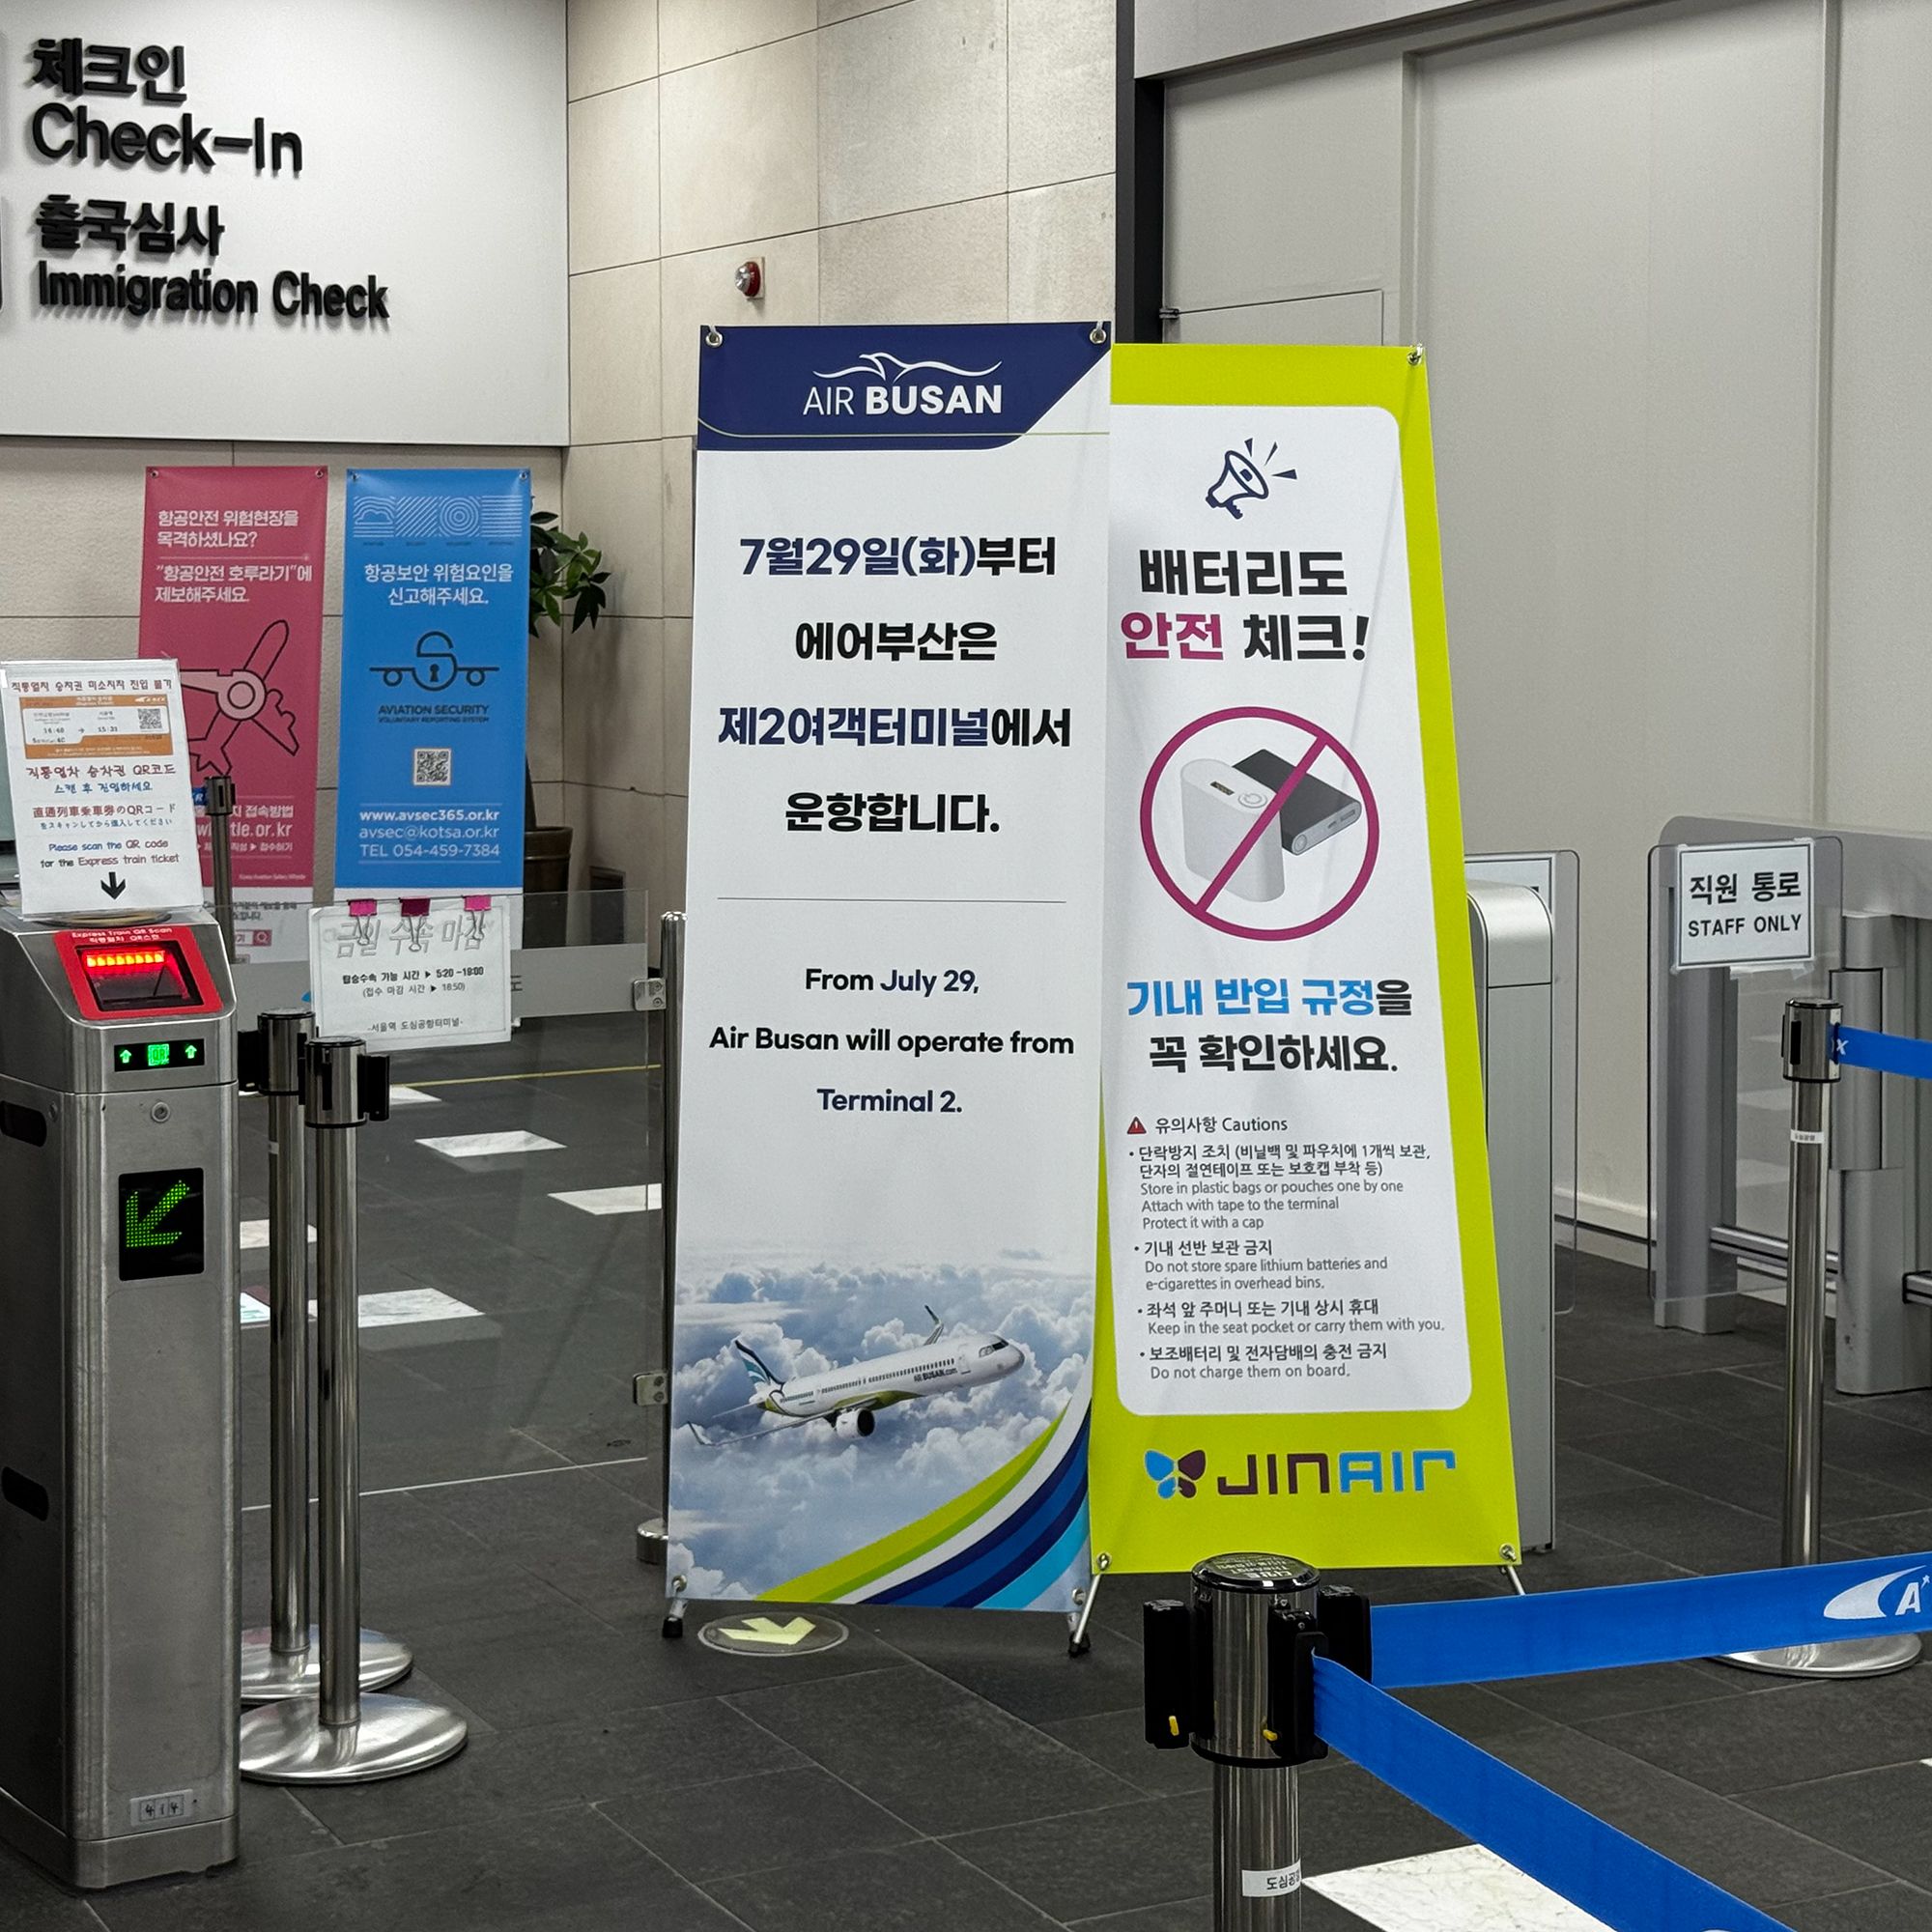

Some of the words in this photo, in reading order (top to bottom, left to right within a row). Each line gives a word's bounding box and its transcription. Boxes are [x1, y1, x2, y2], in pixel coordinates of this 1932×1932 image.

[32, 38, 186, 102] 체크인
[32, 102, 302, 172] Check-In
[36, 194, 224, 256] 출국심사
[39, 261, 258, 316] Immigration
[272, 270, 389, 319] Check
[803, 386, 854, 415] AIR
[866, 384, 1002, 414] BUSAN
[158, 510, 218, 526] 항공안전
[223, 510, 298, 526] 위험현장을
[157, 531, 258, 548] 목격하셨나요?
[740, 536, 1056, 576] 7월29일(화)부터
[365, 563, 429, 582] 항공보안
[434, 563, 514, 582] 위험요인을
[1139, 549, 1348, 597] 배터리도
[155, 586, 249, 603] 제보해주세요.
[388, 587, 489, 606] 신고해주세요.
[795, 622, 997, 662] 에어부산은
[1121, 611, 1223, 660] 안전
[1242, 613, 1369, 661] 체크!
[379, 705, 432, 715] AVIATION
[435, 705, 490, 715] SECURITY
[719, 707, 1070, 747] 제2여객터미널에서
[26, 766, 79, 780] 직통열차
[87, 765, 126, 777] 승차권
[133, 764, 176, 775] QR코드
[54, 783, 76, 794] 스캔
[82, 783, 93, 793] 후
[98, 781, 153, 792] 진입하세요
[359, 810, 499, 821] www.avsec365.or.kr
[785, 792, 1000, 833] 운항합니다.
[359, 826, 499, 841] avsec@kotsa.or.kr
[126, 839, 140, 849] QR
[145, 839, 169, 848] code
[359, 844, 388, 856] TEL
[393, 844, 499, 857] 054-459-7384
[77, 857, 119, 867] Express
[124, 855, 147, 864] train
[151, 854, 179, 864] ticket
[1690, 872, 1738, 905] 직원
[1751, 870, 1801, 902] 통로
[1688, 918, 1745, 937] STAFF
[1753, 914, 1803, 933] ONLY
[806, 969, 873, 990] From
[880, 969, 937, 998] July
[943, 970, 979, 995] 29,
[1127, 980, 1203, 1016] 기내
[1215, 979, 1290, 1015] 반입
[1301, 980, 1411, 1016] 규정을
[709, 1027, 749, 1049] Air
[755, 1028, 838, 1050] Busan
[846, 1029, 891, 1051] will
[896, 1034, 1005, 1057] operate
[1009, 1031, 1074, 1054] from
[1150, 1037, 1187, 1073] 꼭
[1198, 1035, 1398, 1071] 확인하세요.
[816, 1088, 934, 1112] Terminal
[940, 1092, 963, 1113] 2.
[1155, 1118, 1216, 1133] 유의사항
[1222, 1117, 1288, 1131] Cautions
[1139, 1146, 1197, 1162] 단락방지
[1202, 1145, 1230, 1159] 조치
[1235, 1145, 1281, 1160] (비닐백
[1285, 1145, 1298, 1159] 및
[1303, 1145, 1357, 1158] 파우치에
[1362, 1144, 1395, 1158] 1개씩
[1399, 1145, 1431, 1159] 보관,
[1140, 1163, 1180, 1179] 단자의
[1184, 1162, 1253, 1178] 절연테이프
[1258, 1161, 1284, 1177] 또는
[1289, 1161, 1330, 1177] 보호캡
[1334, 1161, 1360, 1176] 부착
[1364, 1160, 1383, 1177] 등)
[1141, 1182, 1175, 1195] Store
[1177, 1182, 1188, 1194] in
[1192, 1181, 1230, 1197] plastic
[1233, 1181, 1262, 1197] bags
[1264, 1183, 1278, 1193] or
[1281, 1180, 1333, 1195] pouches
[1337, 1182, 1360, 1192] one
[1363, 1179, 1378, 1195] by
[1380, 1181, 1404, 1192] one
[1144, 1241, 1173, 1257] 기내
[1178, 1240, 1207, 1256] 선반
[1210, 1240, 1239, 1255] 보관
[1243, 1239, 1272, 1255] 금지
[1146, 1277, 1216, 1293] e-cigarettes
[1220, 1277, 1231, 1290] in
[1235, 1277, 1292, 1290] overhead
[1294, 1276, 1324, 1289] bins.
[1147, 1302, 1176, 1318] 좌석
[1180, 1302, 1196, 1318] 앞
[1200, 1301, 1242, 1318] 주머니
[1246, 1301, 1276, 1316] 또는
[1281, 1300, 1310, 1316] 기내
[1315, 1299, 1344, 1316] 상시
[1349, 1298, 1378, 1315] 휴대
[1148, 1321, 1180, 1336] Keep
[1183, 1321, 1196, 1334] in
[1199, 1321, 1220, 1334] the
[1223, 1322, 1249, 1333] seat
[1251, 1321, 1294, 1335] pocket
[1297, 1322, 1311, 1332] or
[1315, 1321, 1346, 1336] carry
[1350, 1320, 1383, 1332] them
[1386, 1319, 1415, 1331] with
[1418, 1321, 1444, 1334] you.
[1150, 1347, 1221, 1362] 보조배터리
[1227, 1346, 1240, 1361] 및
[1245, 1345, 1318, 1360] 전자담배의
[1322, 1344, 1352, 1359] 충전
[1356, 1343, 1387, 1359] 금지
